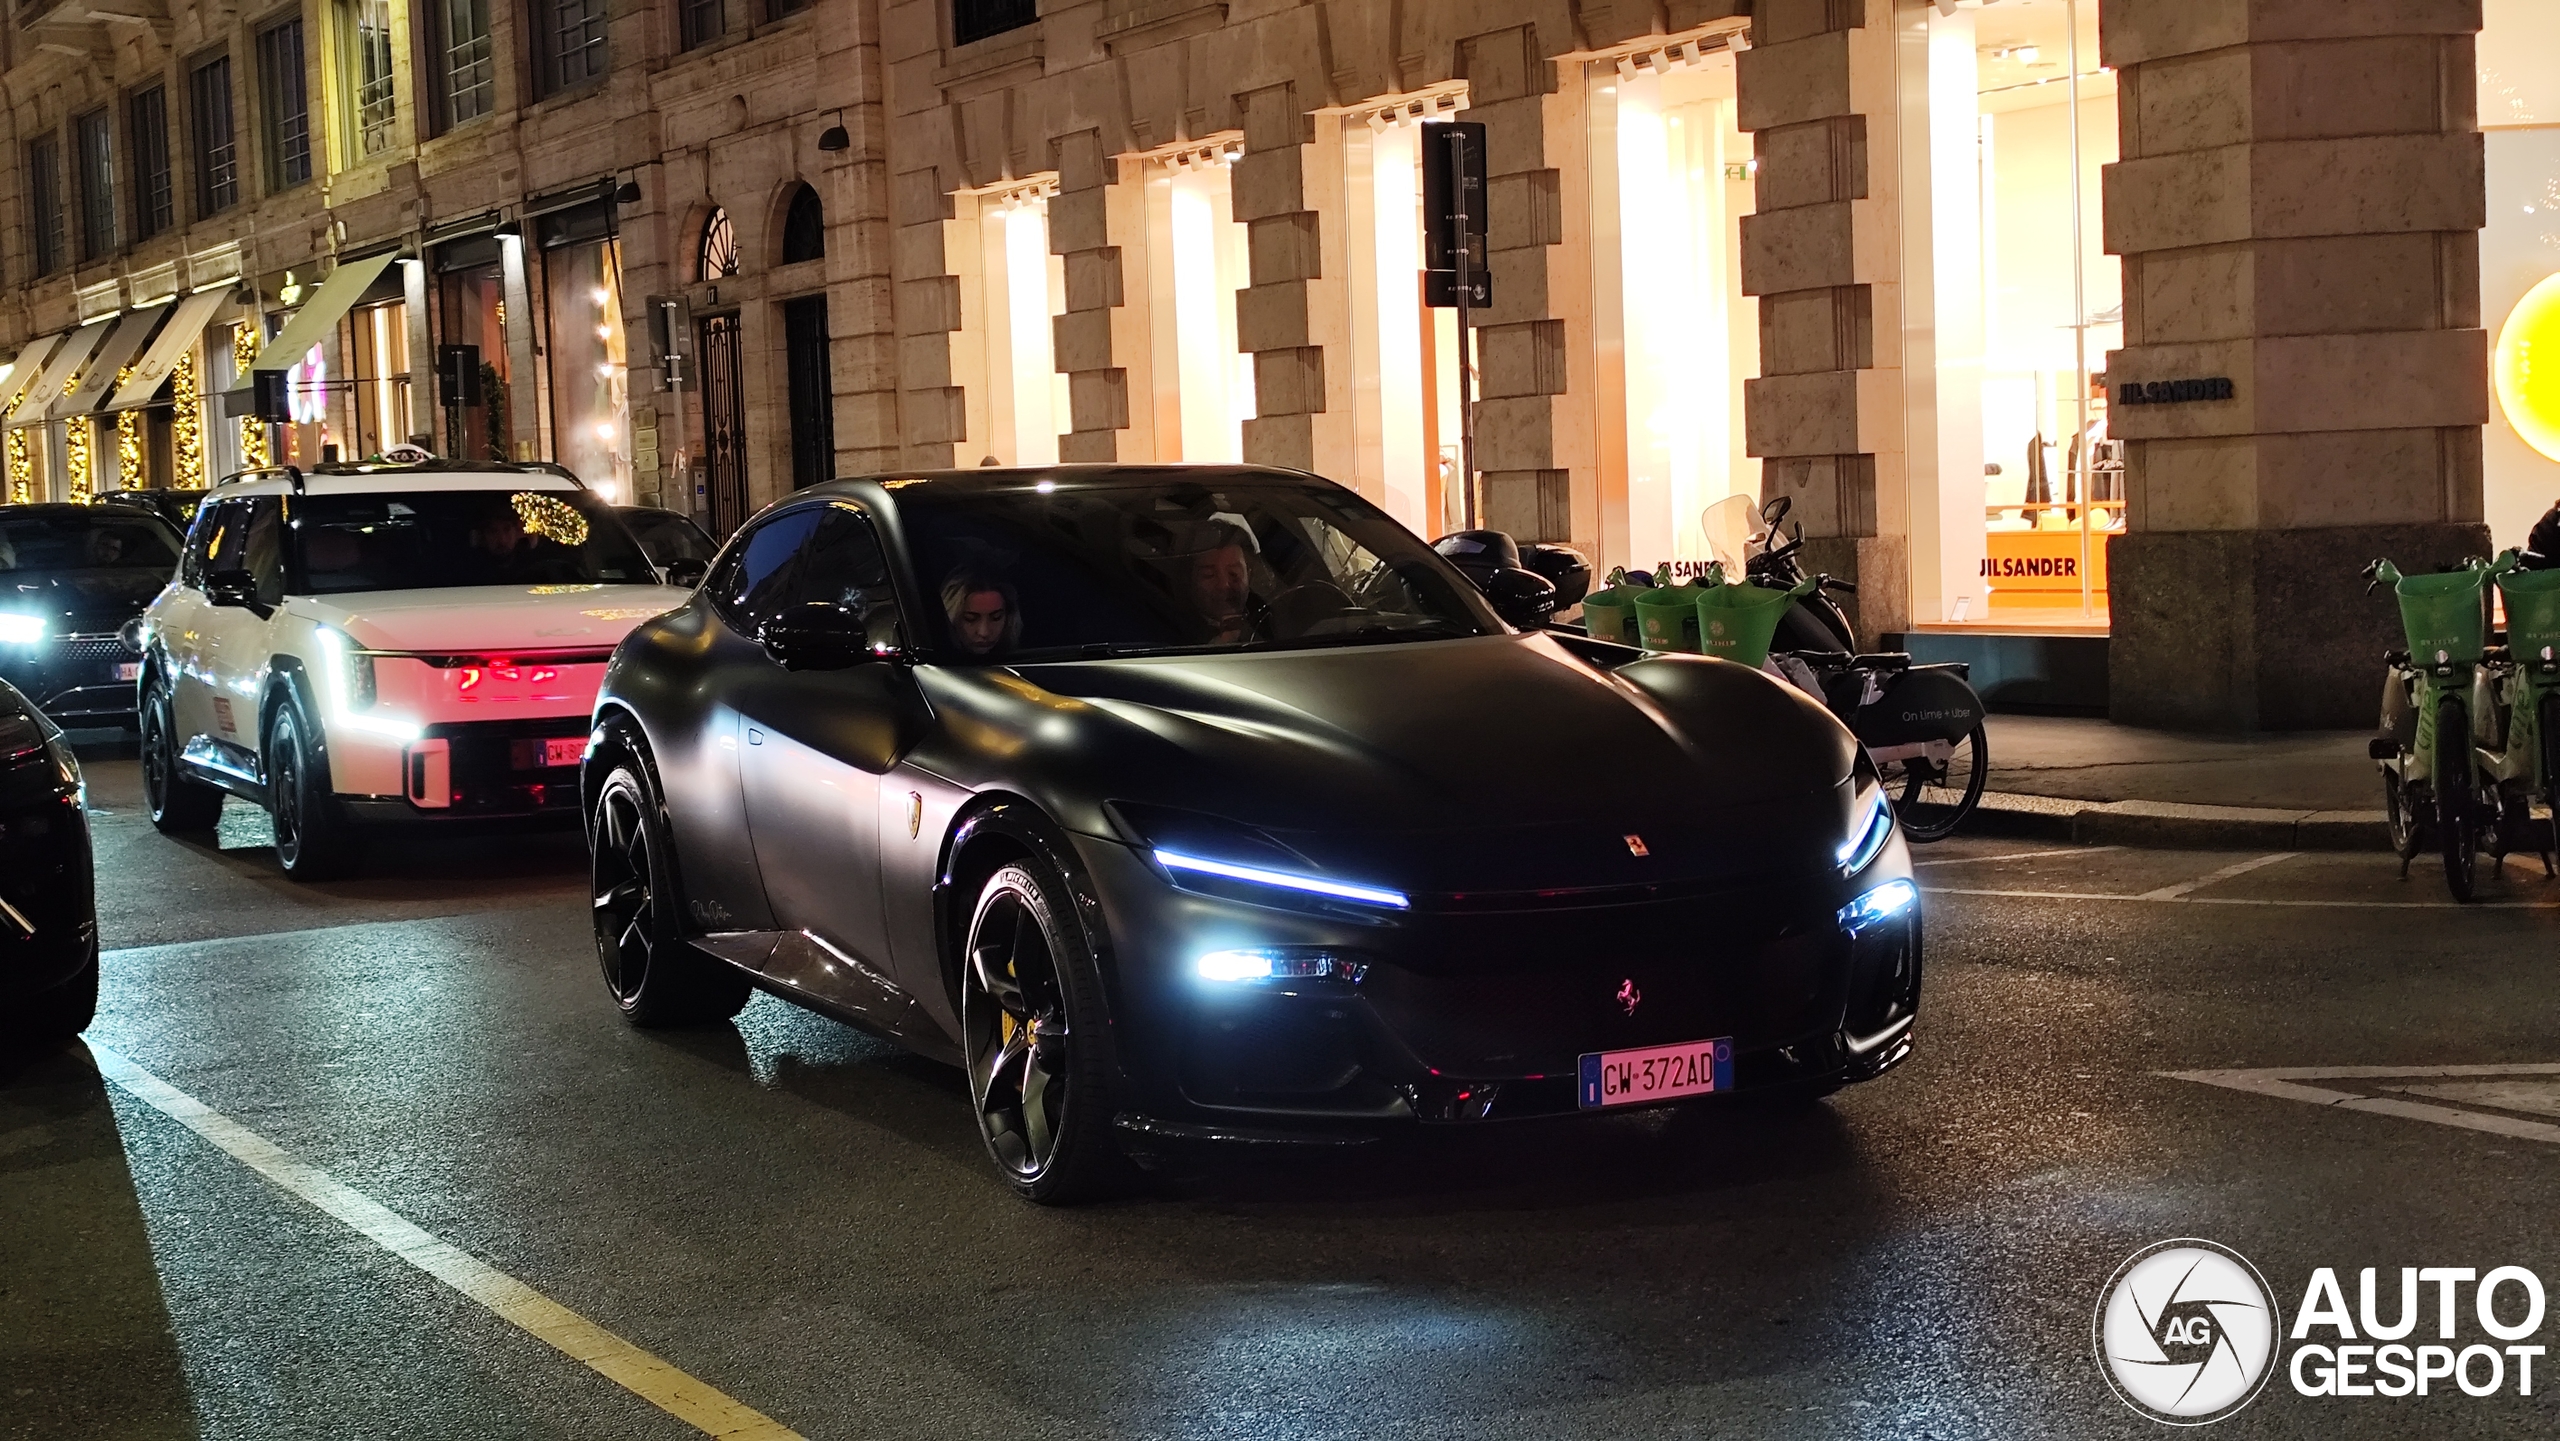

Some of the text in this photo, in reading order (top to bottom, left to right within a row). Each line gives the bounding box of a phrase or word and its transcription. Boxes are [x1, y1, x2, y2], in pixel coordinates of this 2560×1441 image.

[2119, 378, 2233, 405] JIL SANDER
[391, 452, 424, 461] TAXI
[1979, 557, 2077, 577] JIL SANDER
[1902, 711, 1918, 721] On
[1951, 708, 1970, 719] Uber
[1006, 872, 1038, 899] MICHELIN
